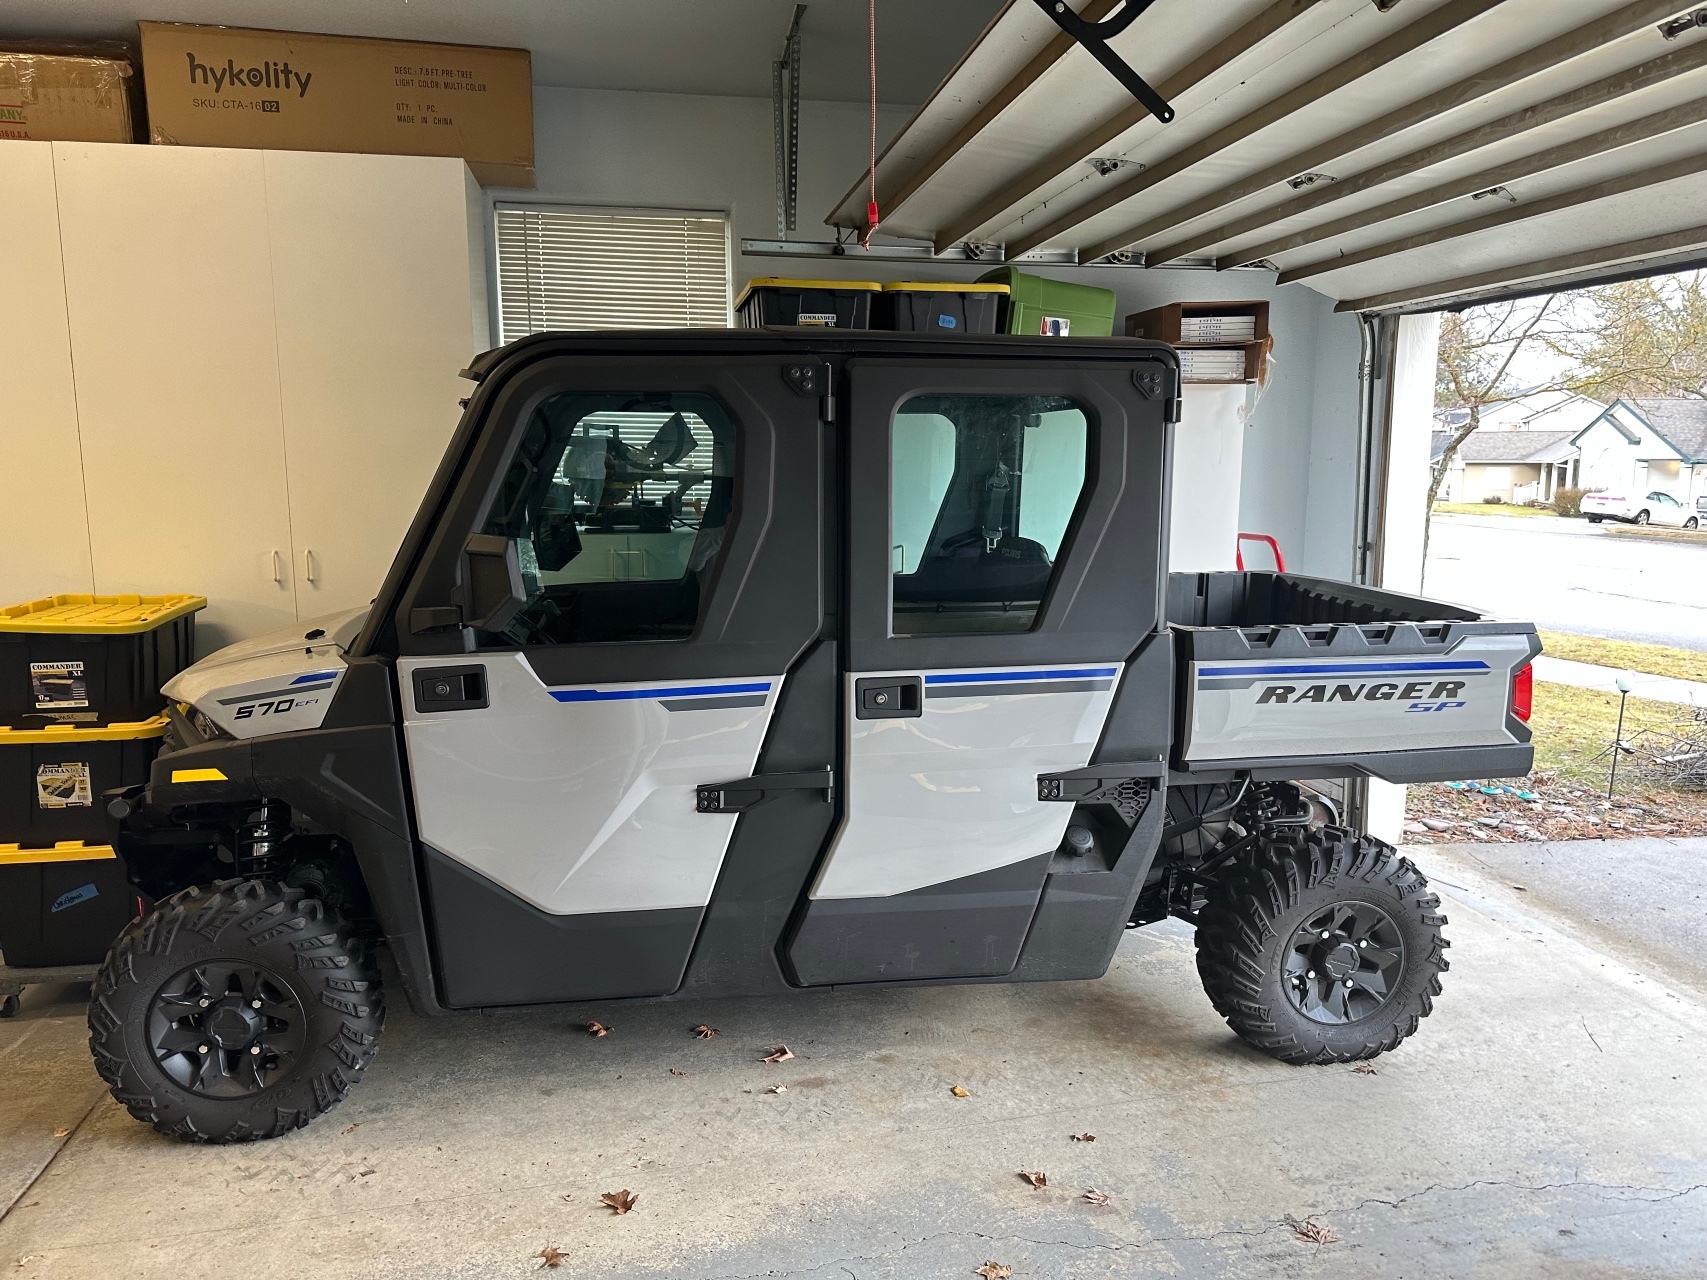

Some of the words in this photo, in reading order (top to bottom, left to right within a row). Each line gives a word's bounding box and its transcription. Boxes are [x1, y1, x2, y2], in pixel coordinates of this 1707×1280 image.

[186, 52, 312, 98] hykolity
[395, 78, 414, 87] LIGHT
[443, 81, 487, 92] MULTI-COLOR
[396, 115, 415, 123] MADE
[420, 115, 428, 124] IN
[433, 117, 453, 126] CHINA
[32, 663, 82, 671] COMMANDER
[1255, 681, 1466, 704] RANGER
[234, 698, 296, 720] 570
[1404, 701, 1467, 713] SP
